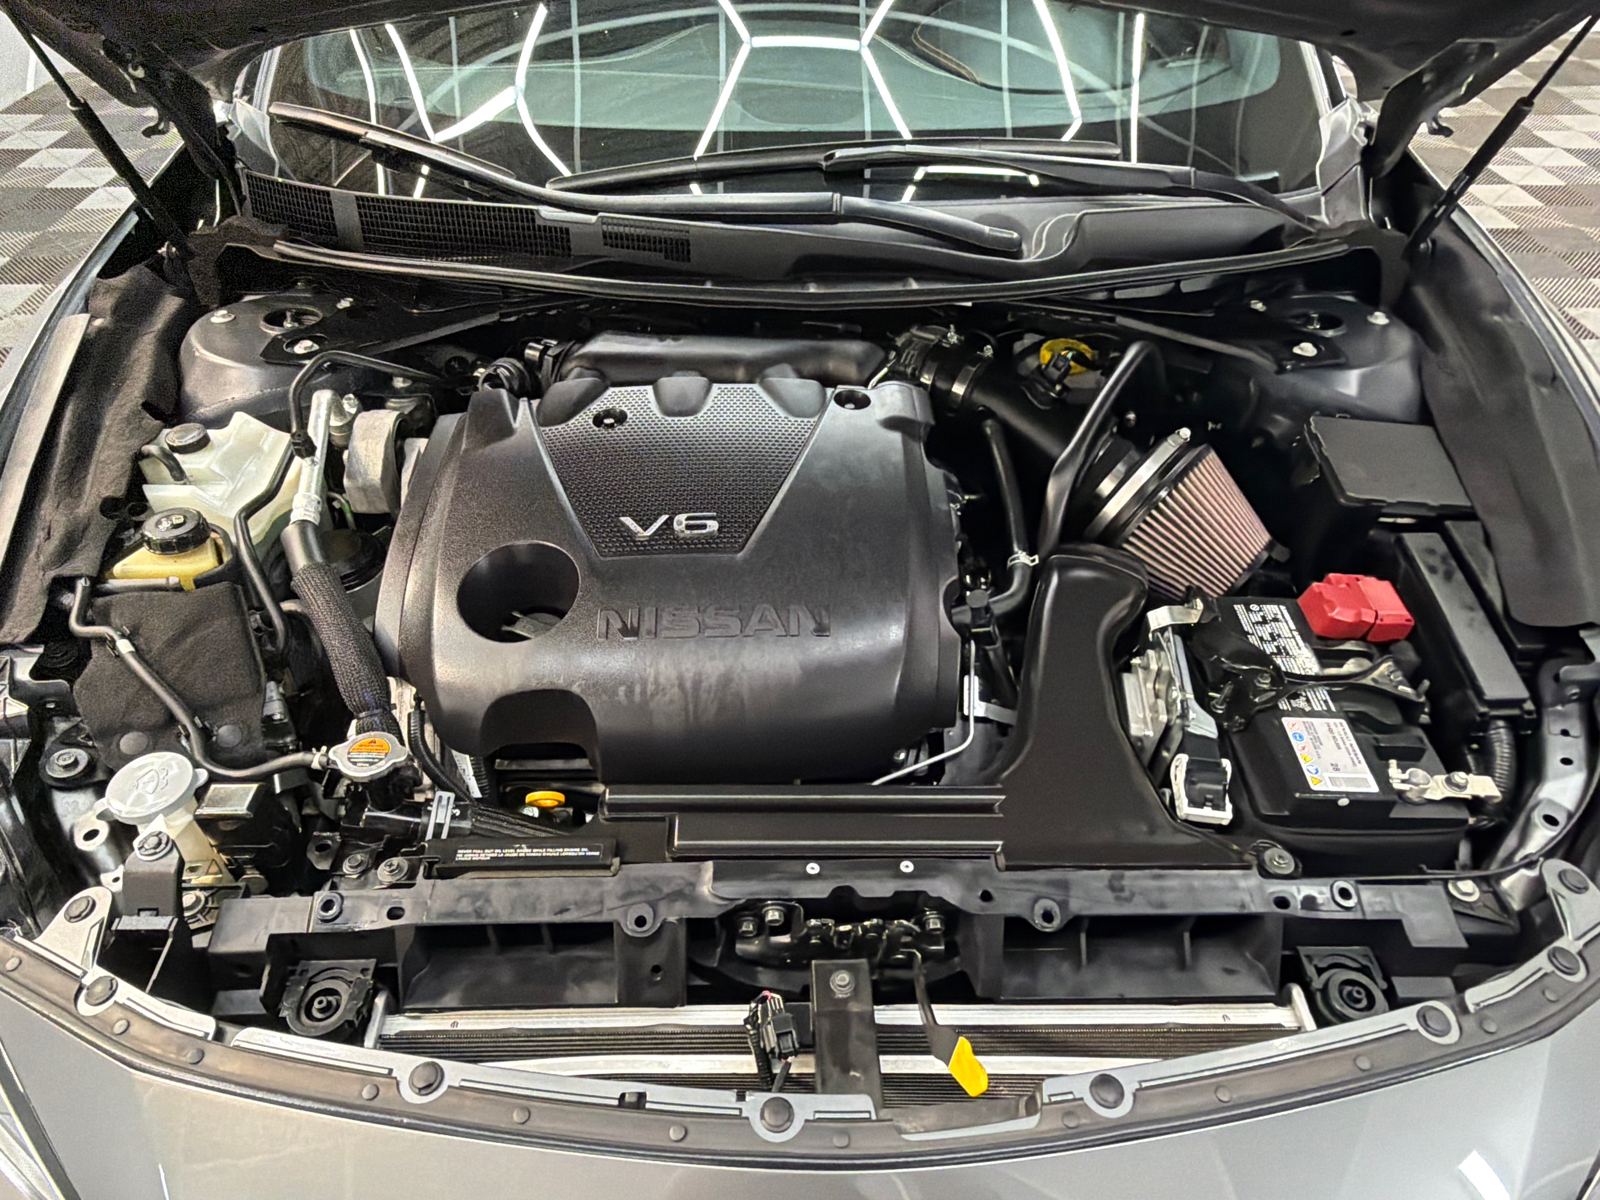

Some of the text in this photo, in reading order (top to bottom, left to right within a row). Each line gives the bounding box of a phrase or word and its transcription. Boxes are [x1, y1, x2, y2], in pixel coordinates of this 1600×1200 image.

[619, 513, 719, 541] V6
[597, 604, 831, 640] NISSAN
[1330, 762, 1341, 772] 28
